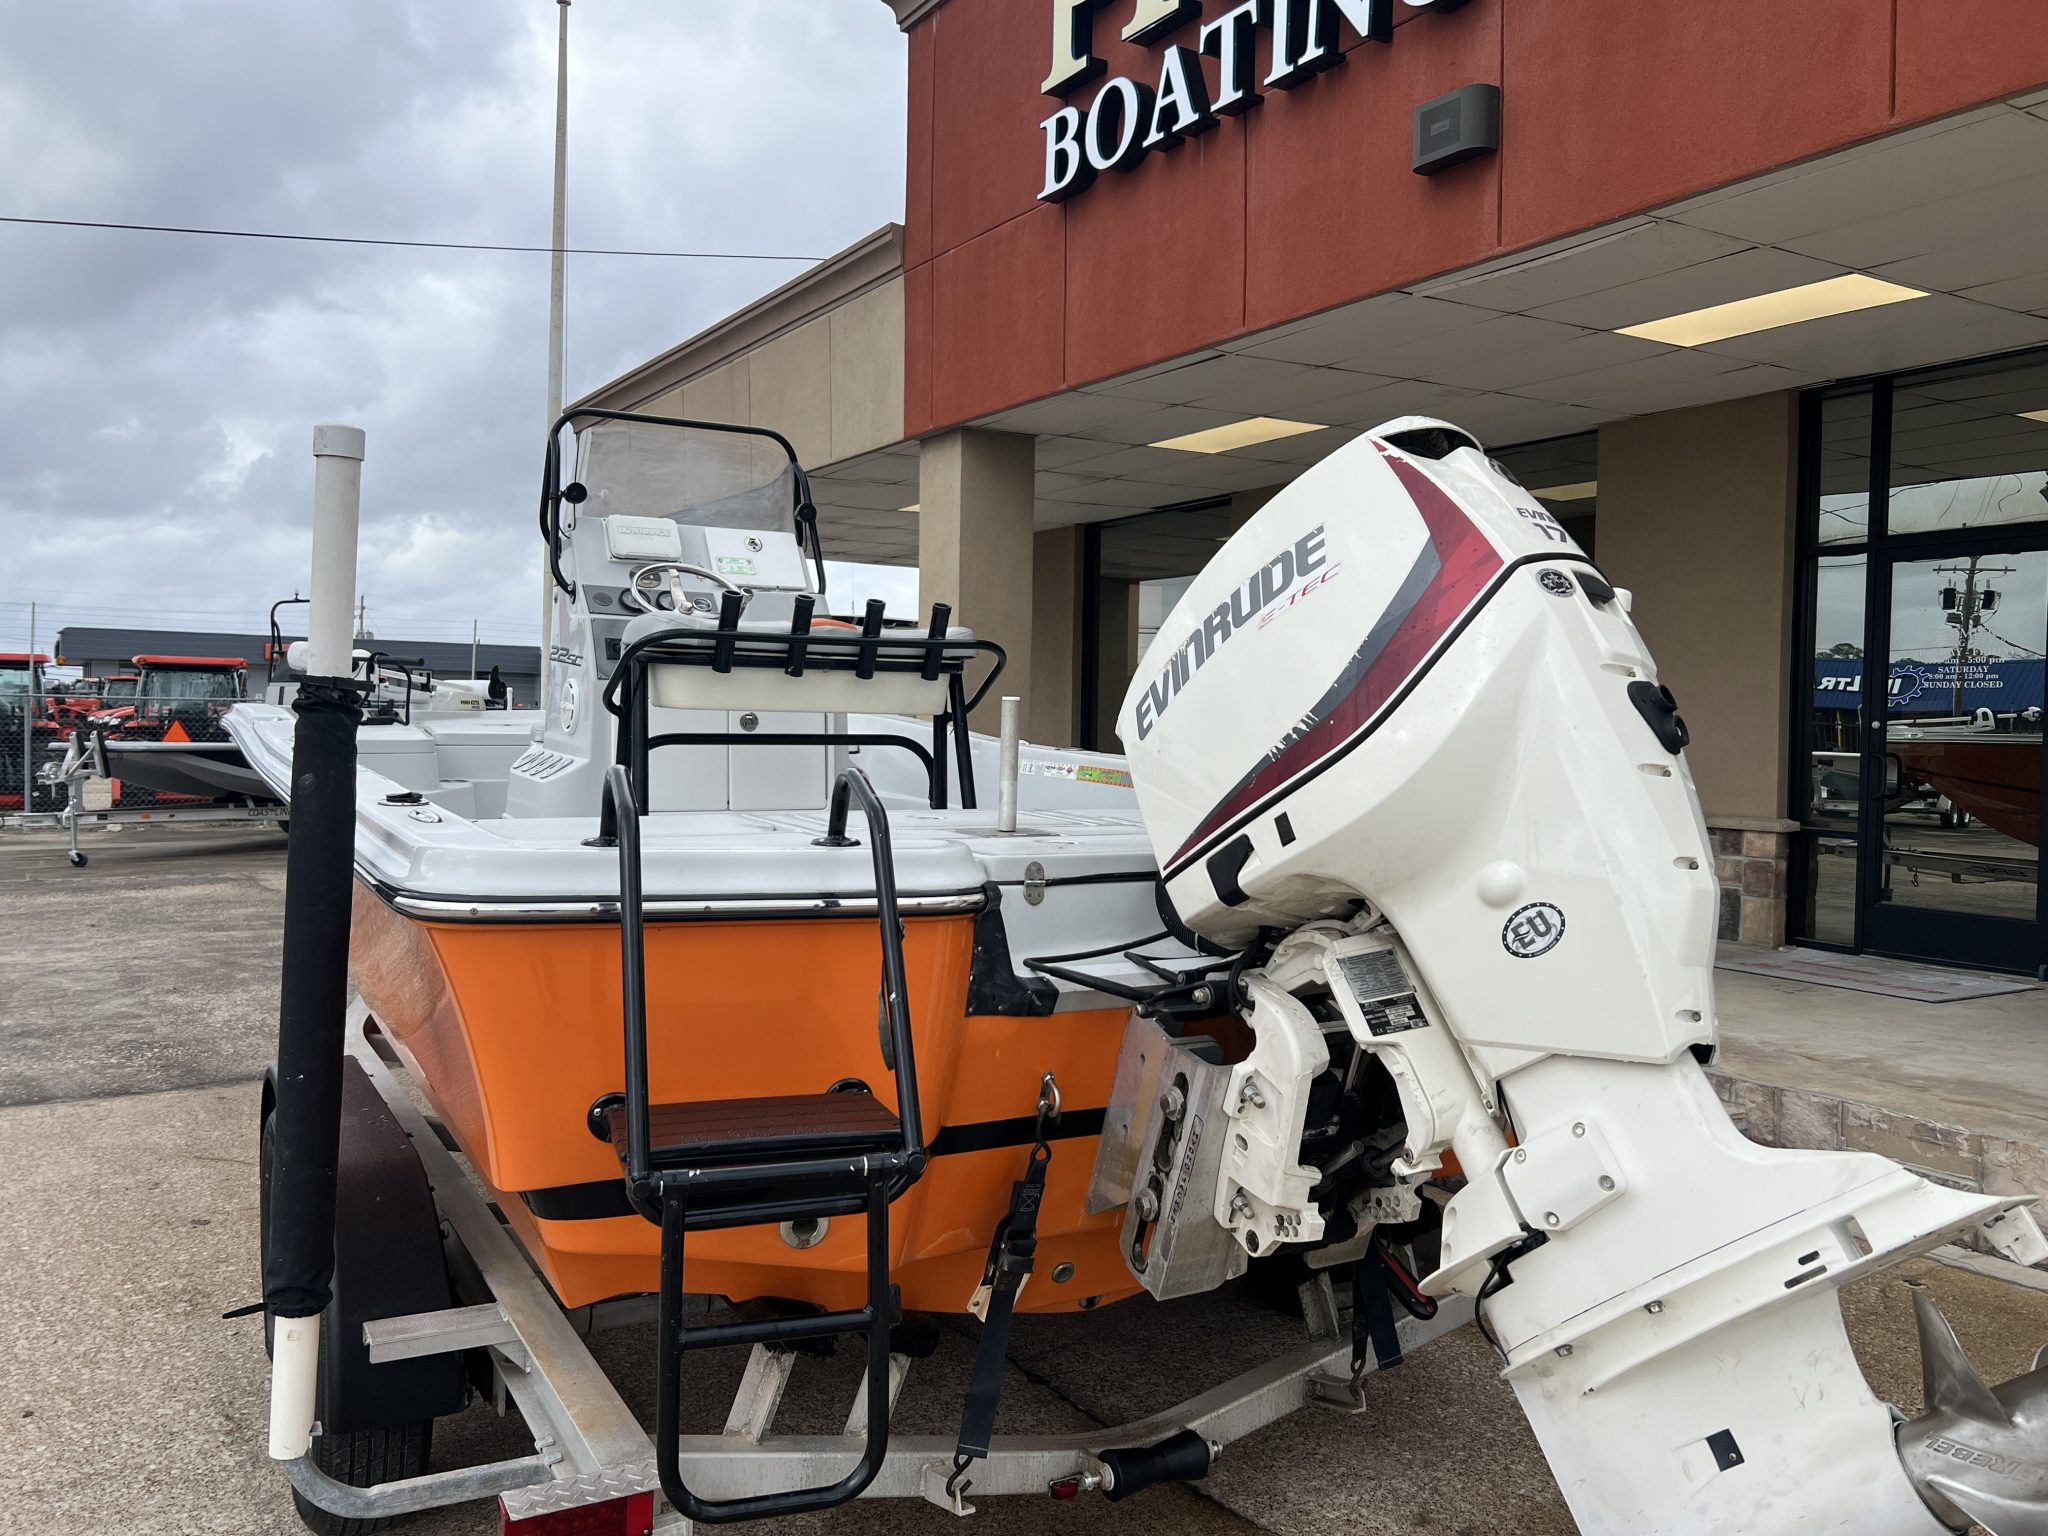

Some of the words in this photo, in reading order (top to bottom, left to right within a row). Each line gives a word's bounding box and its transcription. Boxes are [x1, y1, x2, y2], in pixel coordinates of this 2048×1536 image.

[1037, 0, 1444, 200] BOATIN
[1135, 524, 1327, 741] EVINRUDE
[1938, 665, 1990, 674] SATURDAY
[1967, 656, 1986, 664] 5:00
[1923, 681, 1962, 689] SUNDAY
[1964, 681, 2004, 689] CLOSED
[1924, 1434, 2022, 1476] REBEL
